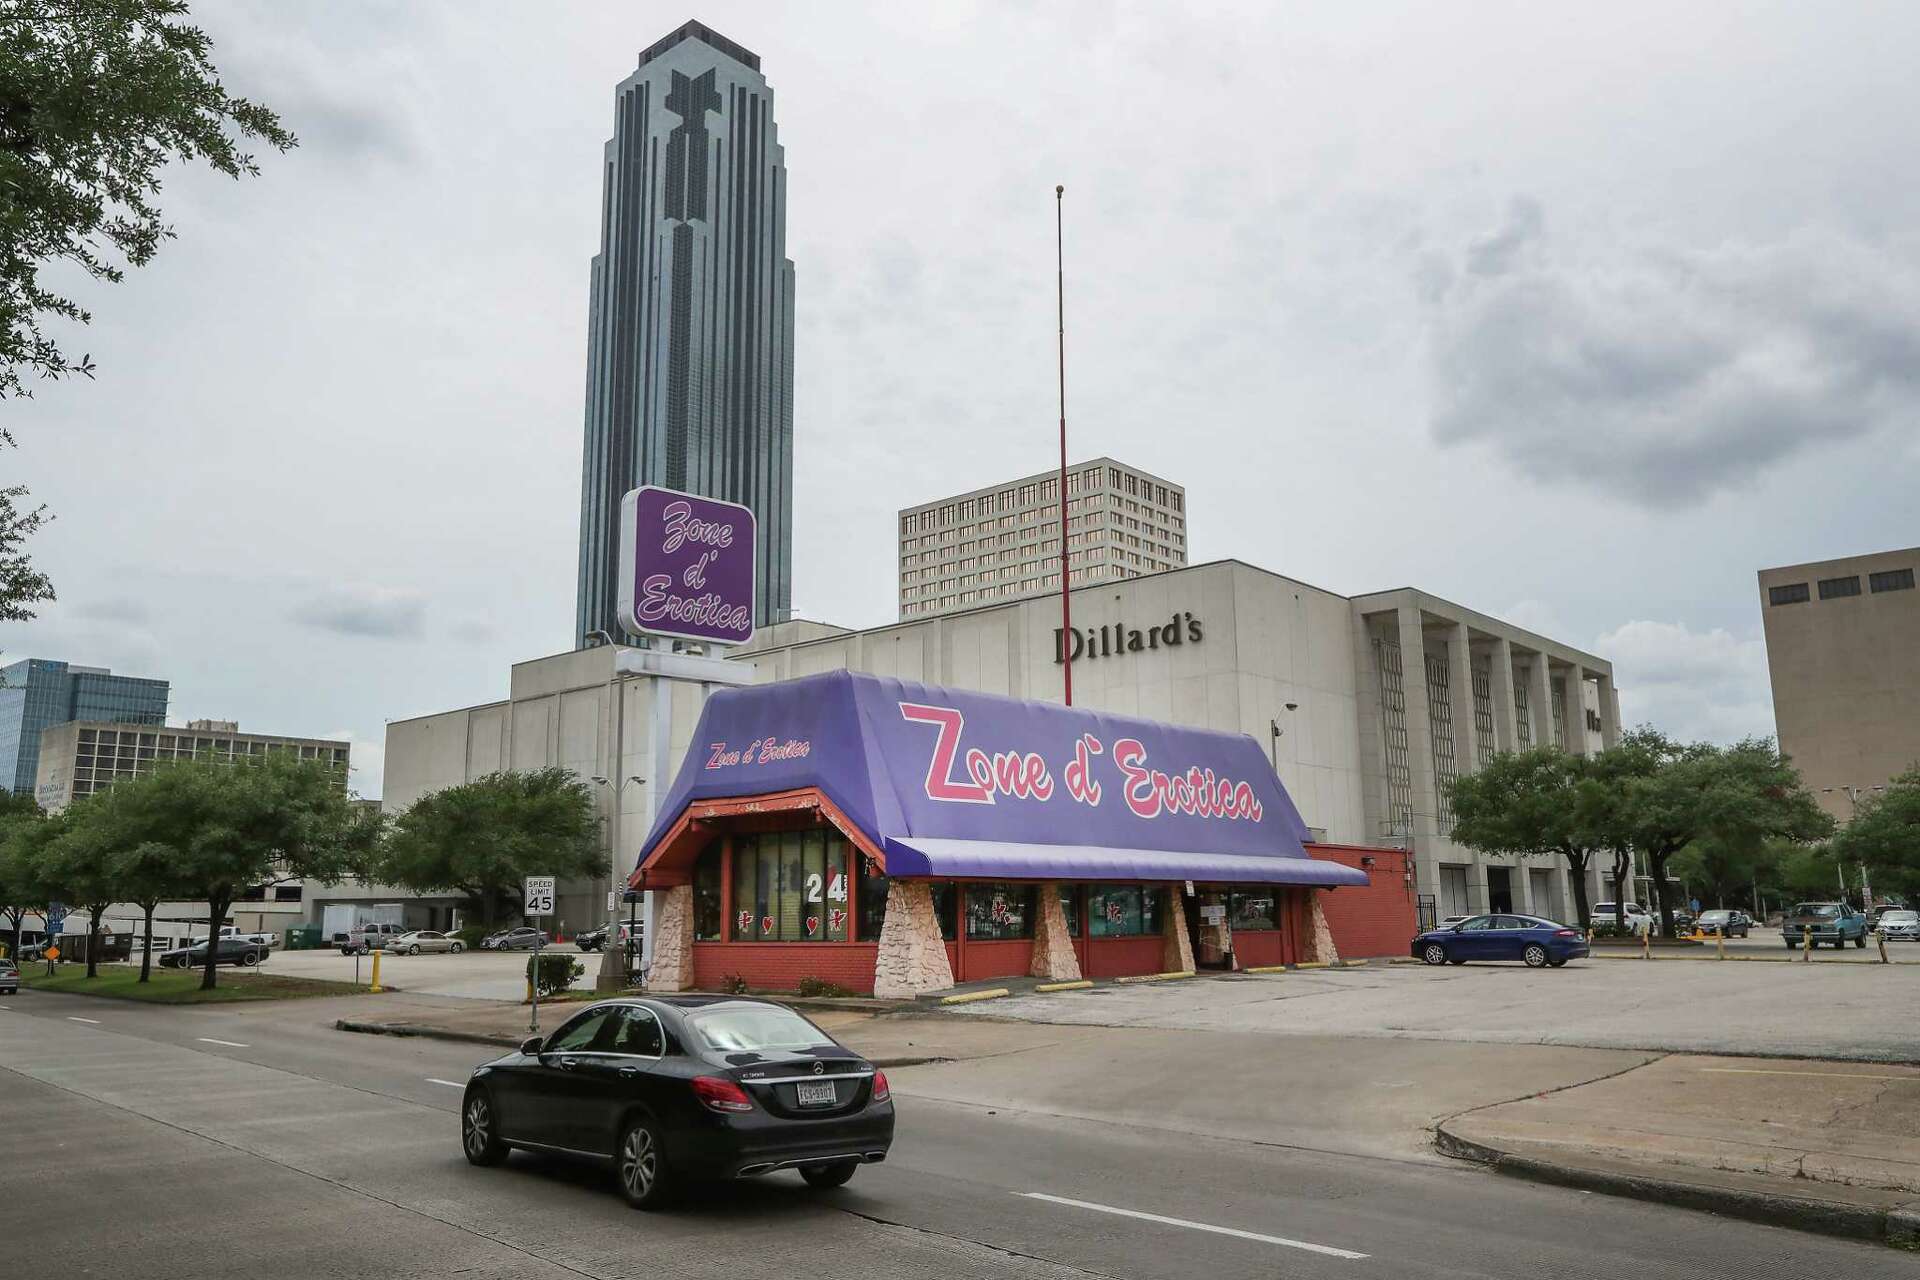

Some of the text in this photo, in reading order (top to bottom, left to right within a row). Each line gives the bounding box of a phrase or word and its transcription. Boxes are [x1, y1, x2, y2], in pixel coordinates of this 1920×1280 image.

[663, 501, 733, 554] Zone
[683, 549, 718, 590] d'
[638, 574, 750, 632] Erotica
[1053, 612, 1203, 664] Dillard's
[704, 742, 740, 769] Zone
[758, 737, 810, 764] Erotica
[899, 702, 1262, 822] Zone d' Erotica
[527, 896, 552, 911] 45
[806, 873, 844, 902] 24
